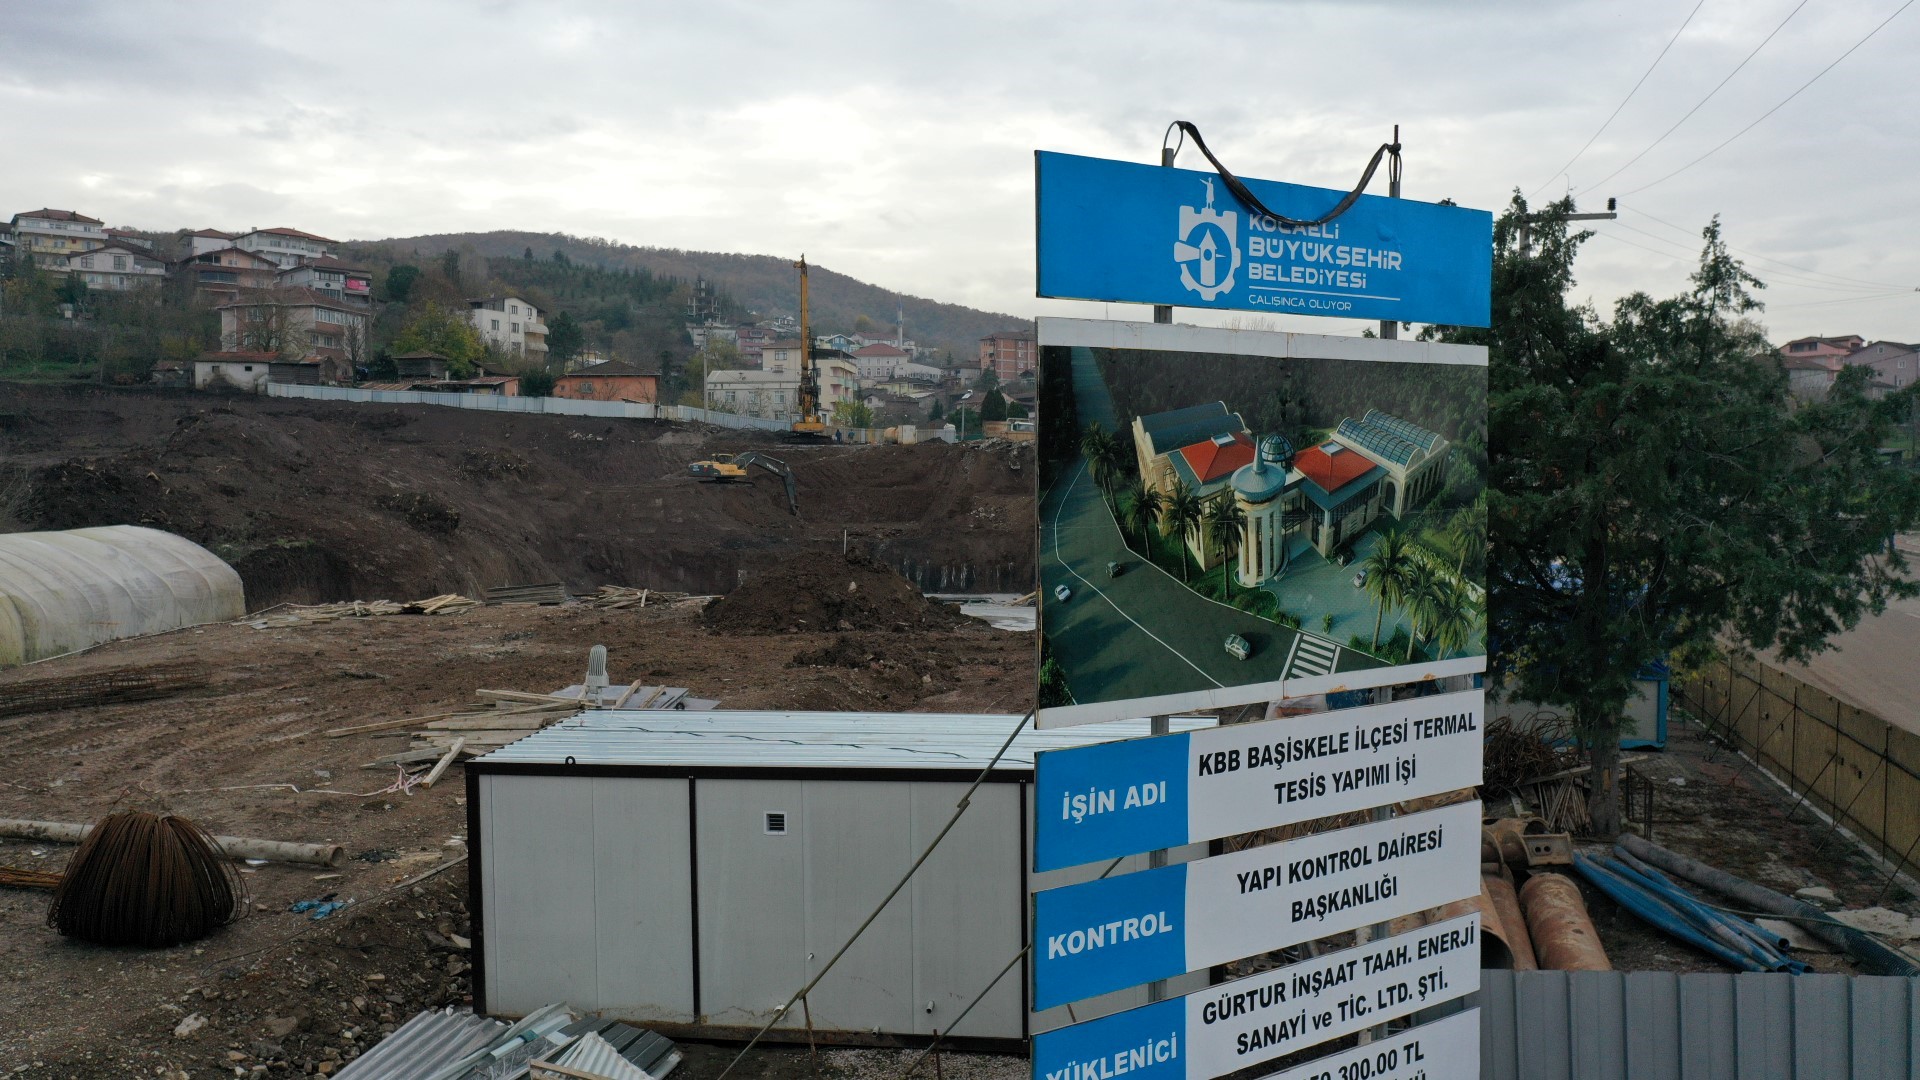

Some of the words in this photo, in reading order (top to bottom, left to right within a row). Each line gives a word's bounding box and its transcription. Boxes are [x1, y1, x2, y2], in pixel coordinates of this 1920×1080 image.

[1248, 294, 1306, 308] ÇALIŞINCA
[1309, 300, 1352, 311] OLUYOR
[1198, 749, 1241, 777] KBB
[1247, 731, 1350, 771] BAŞİSKELE
[1354, 717, 1408, 754] İLÇESİ
[1413, 712, 1477, 741] TERMAL
[1062, 787, 1115, 824] İŞİN
[1123, 781, 1166, 810] ADI
[1273, 771, 1326, 805] TESİS
[1331, 762, 1390, 794] YAPIMI
[1395, 753, 1416, 786] İŞİ
[1236, 865, 1282, 895] YAPI
[1288, 845, 1373, 885] KONTROL
[1377, 823, 1443, 862] DAİRESİ
[1291, 873, 1398, 923] BAŞKANLIĞI
[1048, 911, 1173, 960] KONTROL
[1202, 981, 1287, 1025] GÜRTUR
[1292, 959, 1358, 999] İNŞAAT
[1362, 944, 1412, 977] TAAH.
[1417, 920, 1475, 961] ENERJİ
[1236, 1008, 1306, 1056] SANAYİ
[1311, 1011, 1333, 1031] ve
[1337, 993, 1372, 1022] TİC.
[1377, 982, 1413, 1010] LTD.
[1418, 965, 1448, 1002] ŞTİ.
[1403, 1040, 1425, 1065] TL
